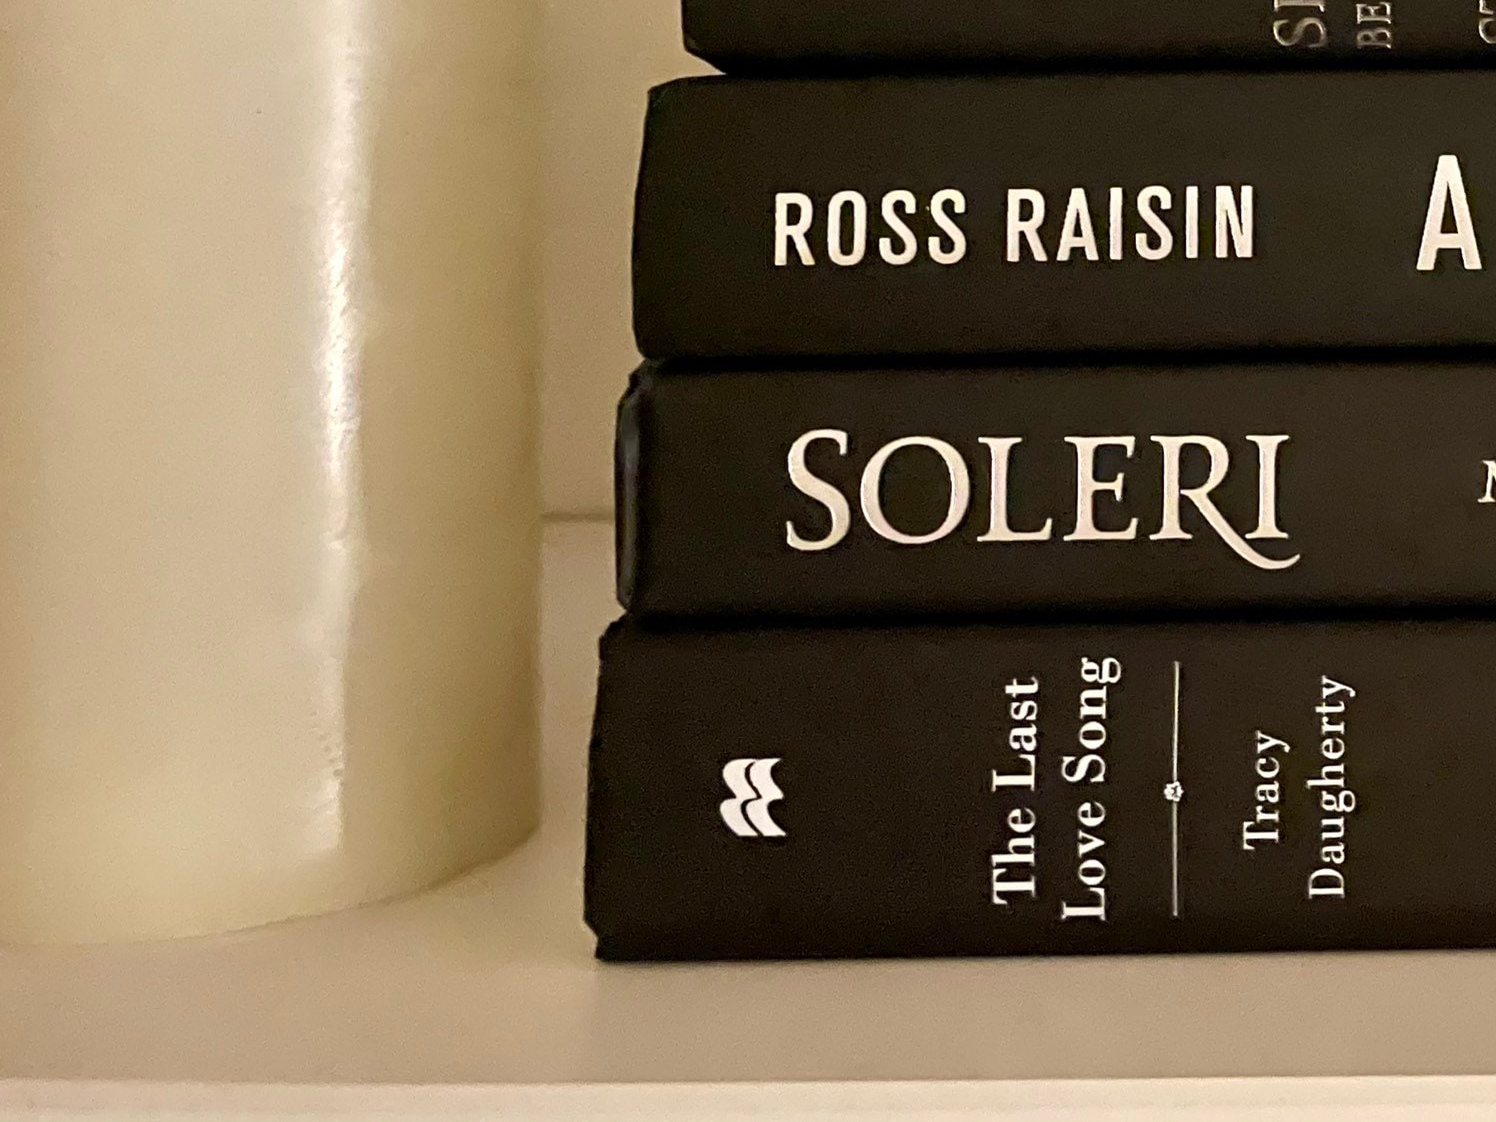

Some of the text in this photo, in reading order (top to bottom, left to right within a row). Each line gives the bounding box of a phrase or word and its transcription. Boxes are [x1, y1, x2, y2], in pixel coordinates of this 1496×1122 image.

[774, 184, 1254, 267] ROSS RAISIN
[1415, 154, 1483, 271] A
[785, 428, 1301, 570] SOLERI
[990, 676, 1039, 905] The Last
[1060, 656, 1122, 921] Love Song
[1242, 729, 1291, 851] Tracy
[1305, 674, 1356, 899] Daugherty
